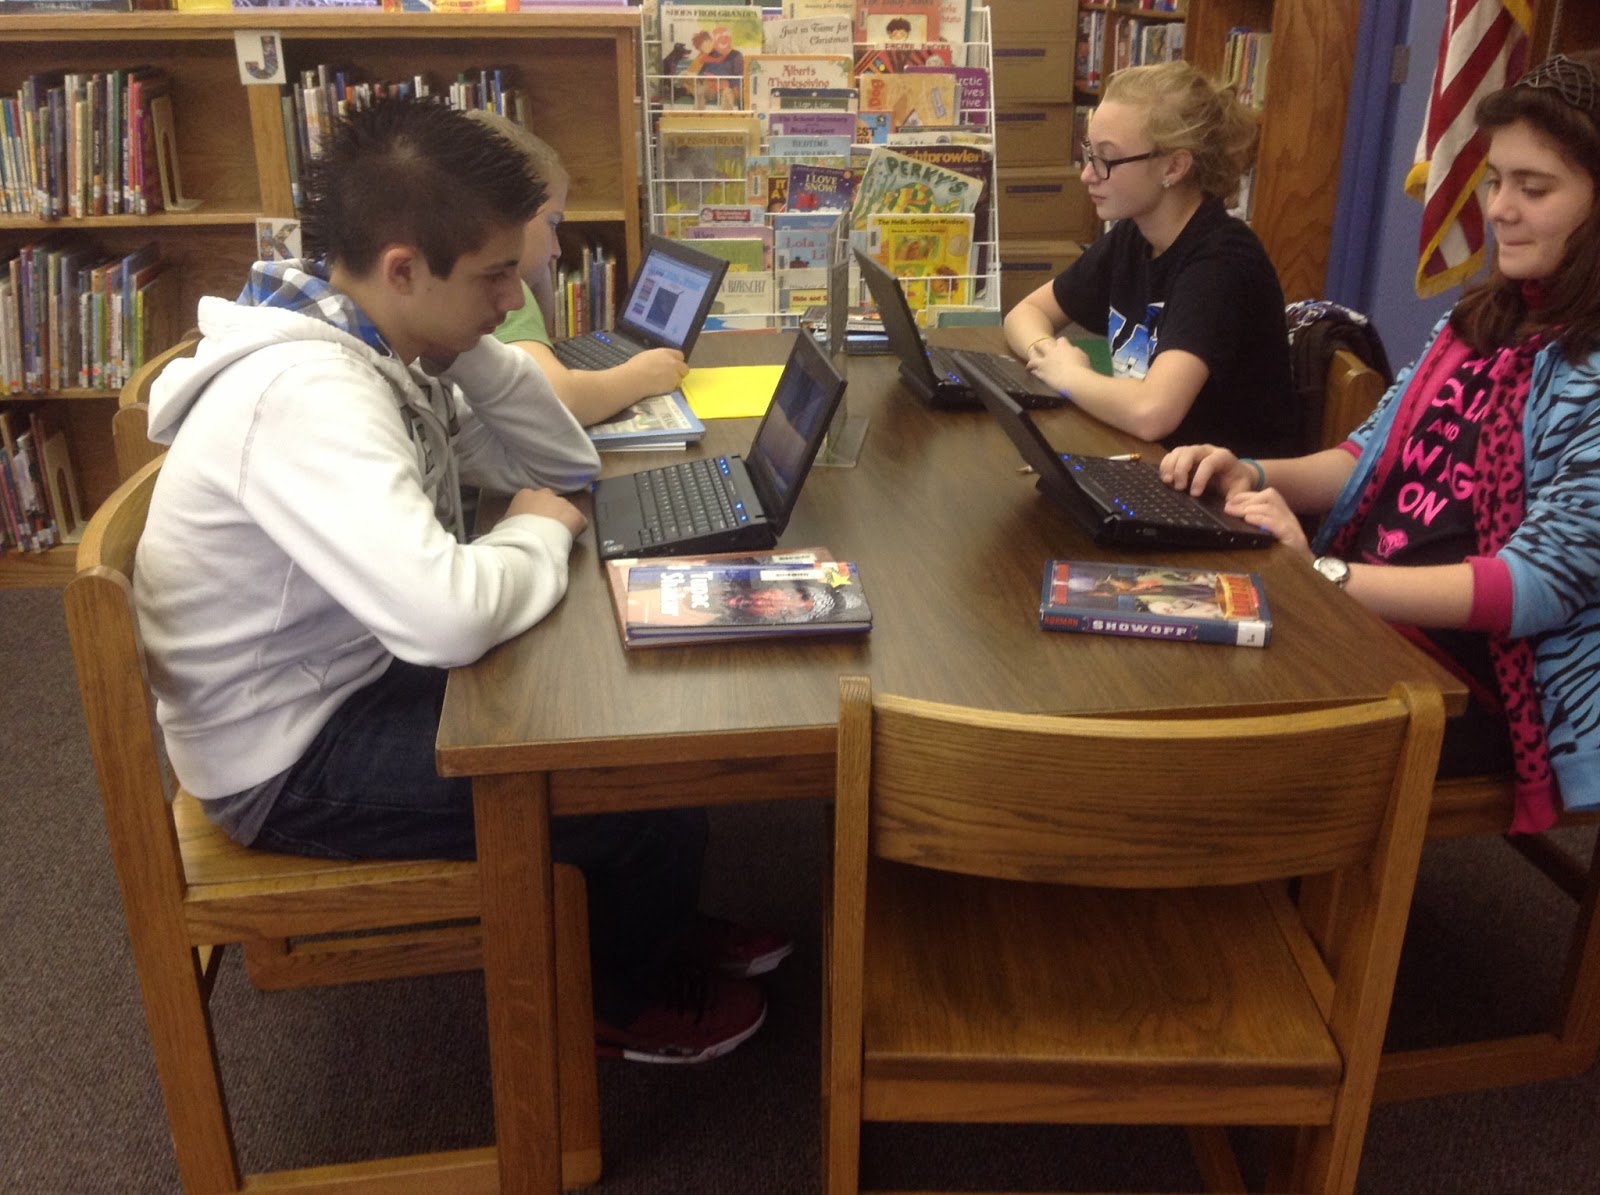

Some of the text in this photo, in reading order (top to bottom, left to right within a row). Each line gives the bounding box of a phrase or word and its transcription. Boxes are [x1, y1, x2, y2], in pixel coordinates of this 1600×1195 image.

[665, 9, 758, 19] SHOES FROM GRANDPA
[836, 22, 848, 34] for
[809, 35, 849, 46] Christmas
[244, 35, 279, 80] J
[782, 64, 817, 77] Albert's
[767, 77, 831, 89] Thanksgiving
[958, 77, 983, 87] rctic
[960, 88, 985, 97] ives
[811, 174, 839, 186] LOVE
[804, 182, 838, 194] SNOW!
[258, 221, 300, 261] K
[785, 236, 816, 249] Lola
[1426, 418, 1460, 442] AND
[1397, 481, 1450, 528] ON
